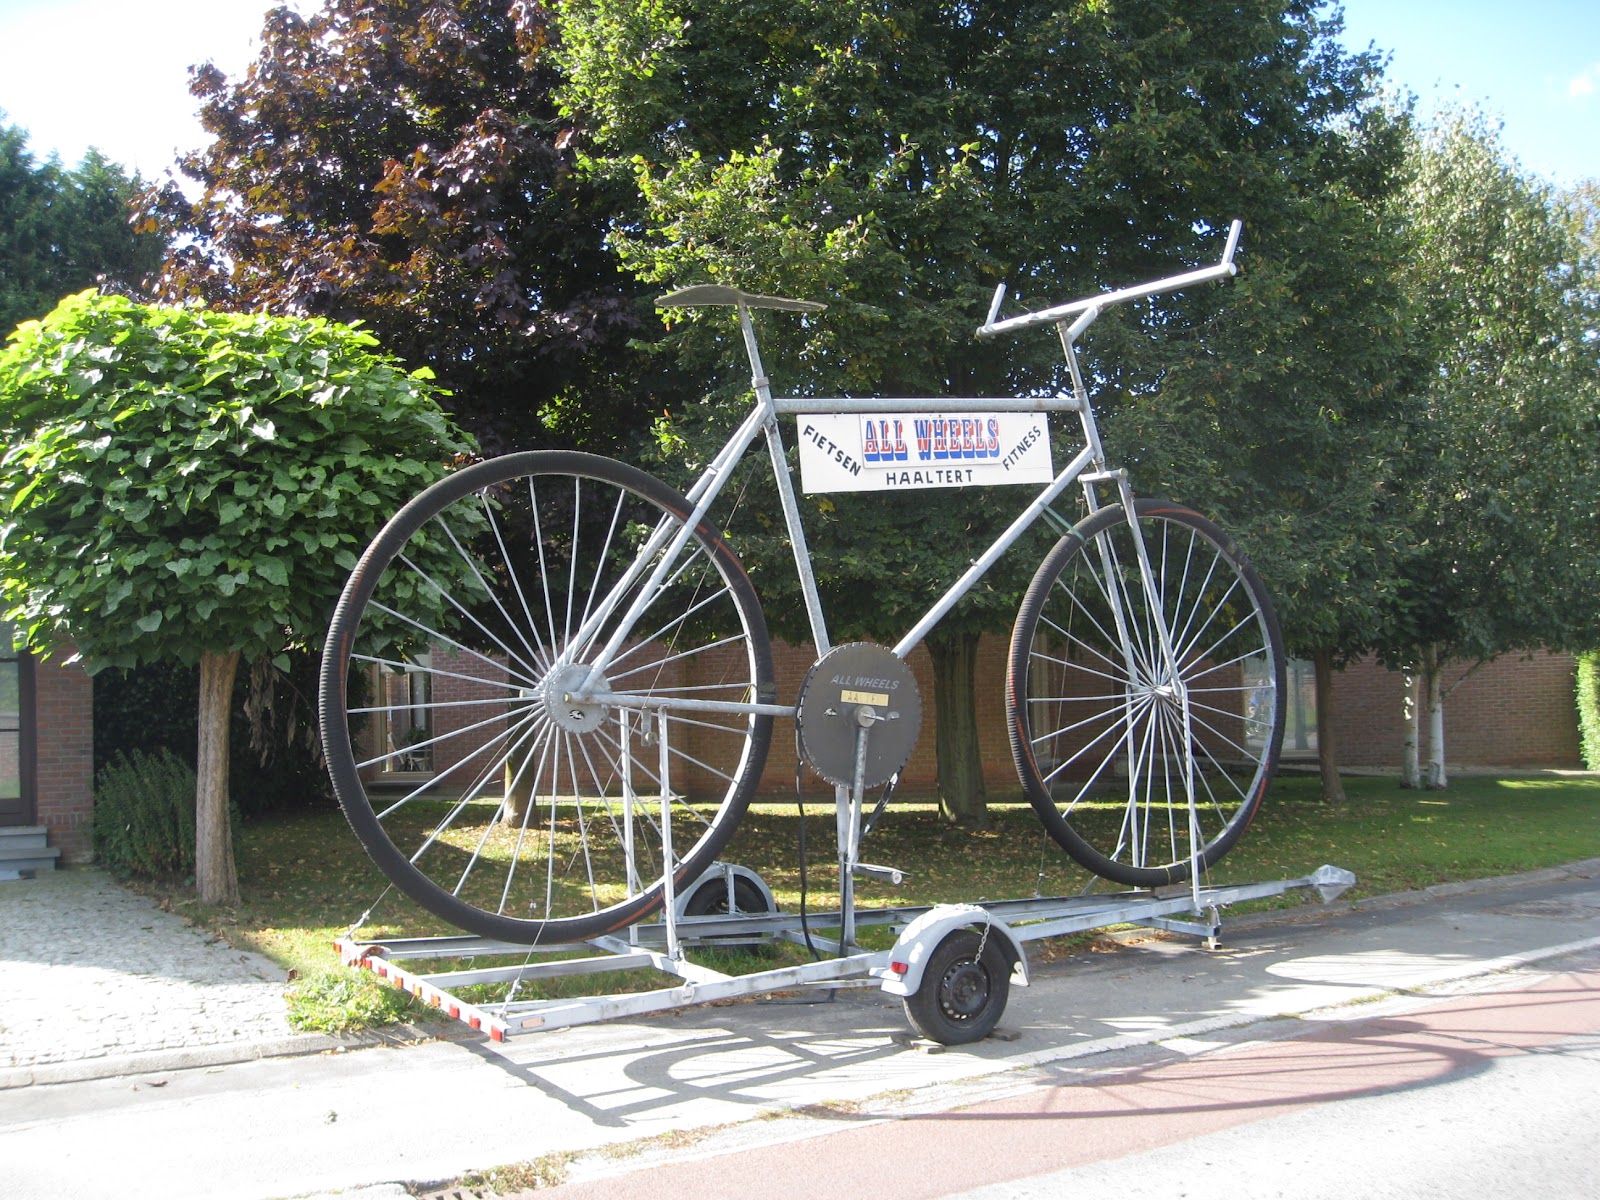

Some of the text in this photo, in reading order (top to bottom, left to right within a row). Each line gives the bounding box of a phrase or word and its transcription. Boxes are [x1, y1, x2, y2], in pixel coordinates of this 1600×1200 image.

[803, 424, 862, 477] FIETSEN
[862, 416, 1002, 462] ALL WHEELS
[1001, 425, 1042, 471] FITNESS
[886, 469, 974, 486] HAALTERT
[830, 674, 900, 690] ALL WHEELS
